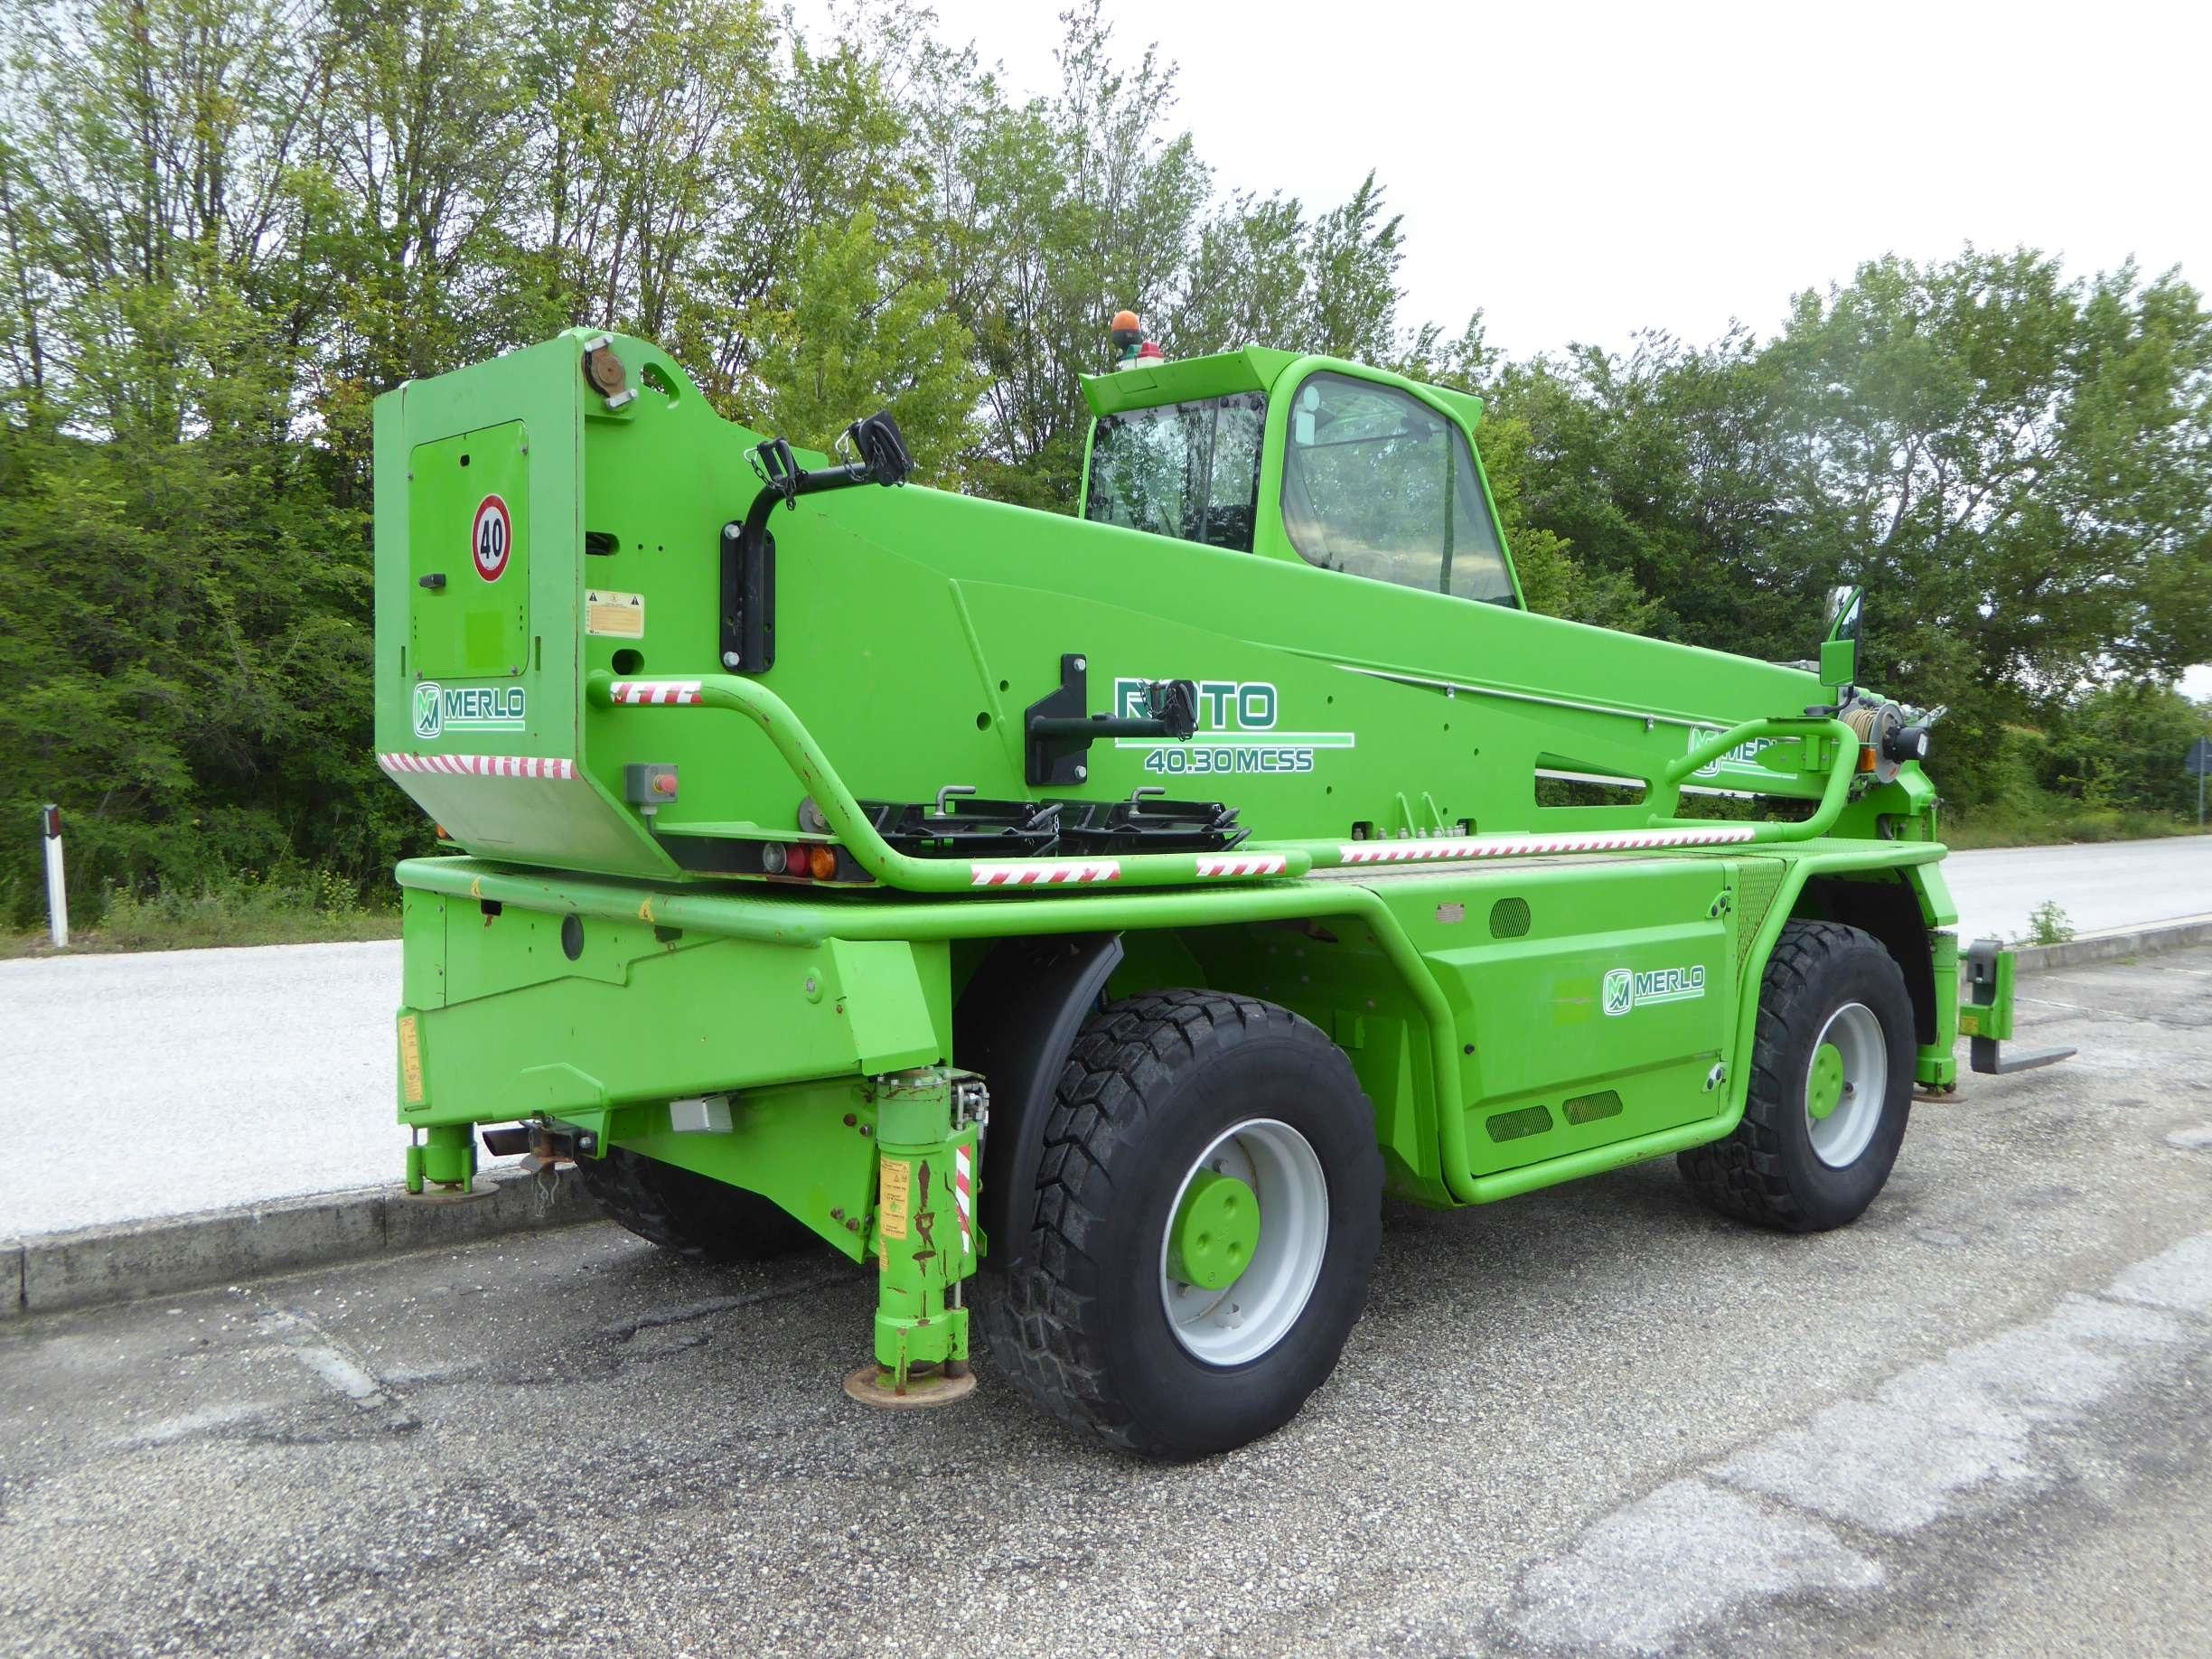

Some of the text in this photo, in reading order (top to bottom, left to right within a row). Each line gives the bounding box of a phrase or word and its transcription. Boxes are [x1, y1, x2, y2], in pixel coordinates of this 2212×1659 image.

[481, 518, 502, 559] 40
[444, 688, 525, 718] MERLO
[1635, 965, 1705, 997] MERLO
